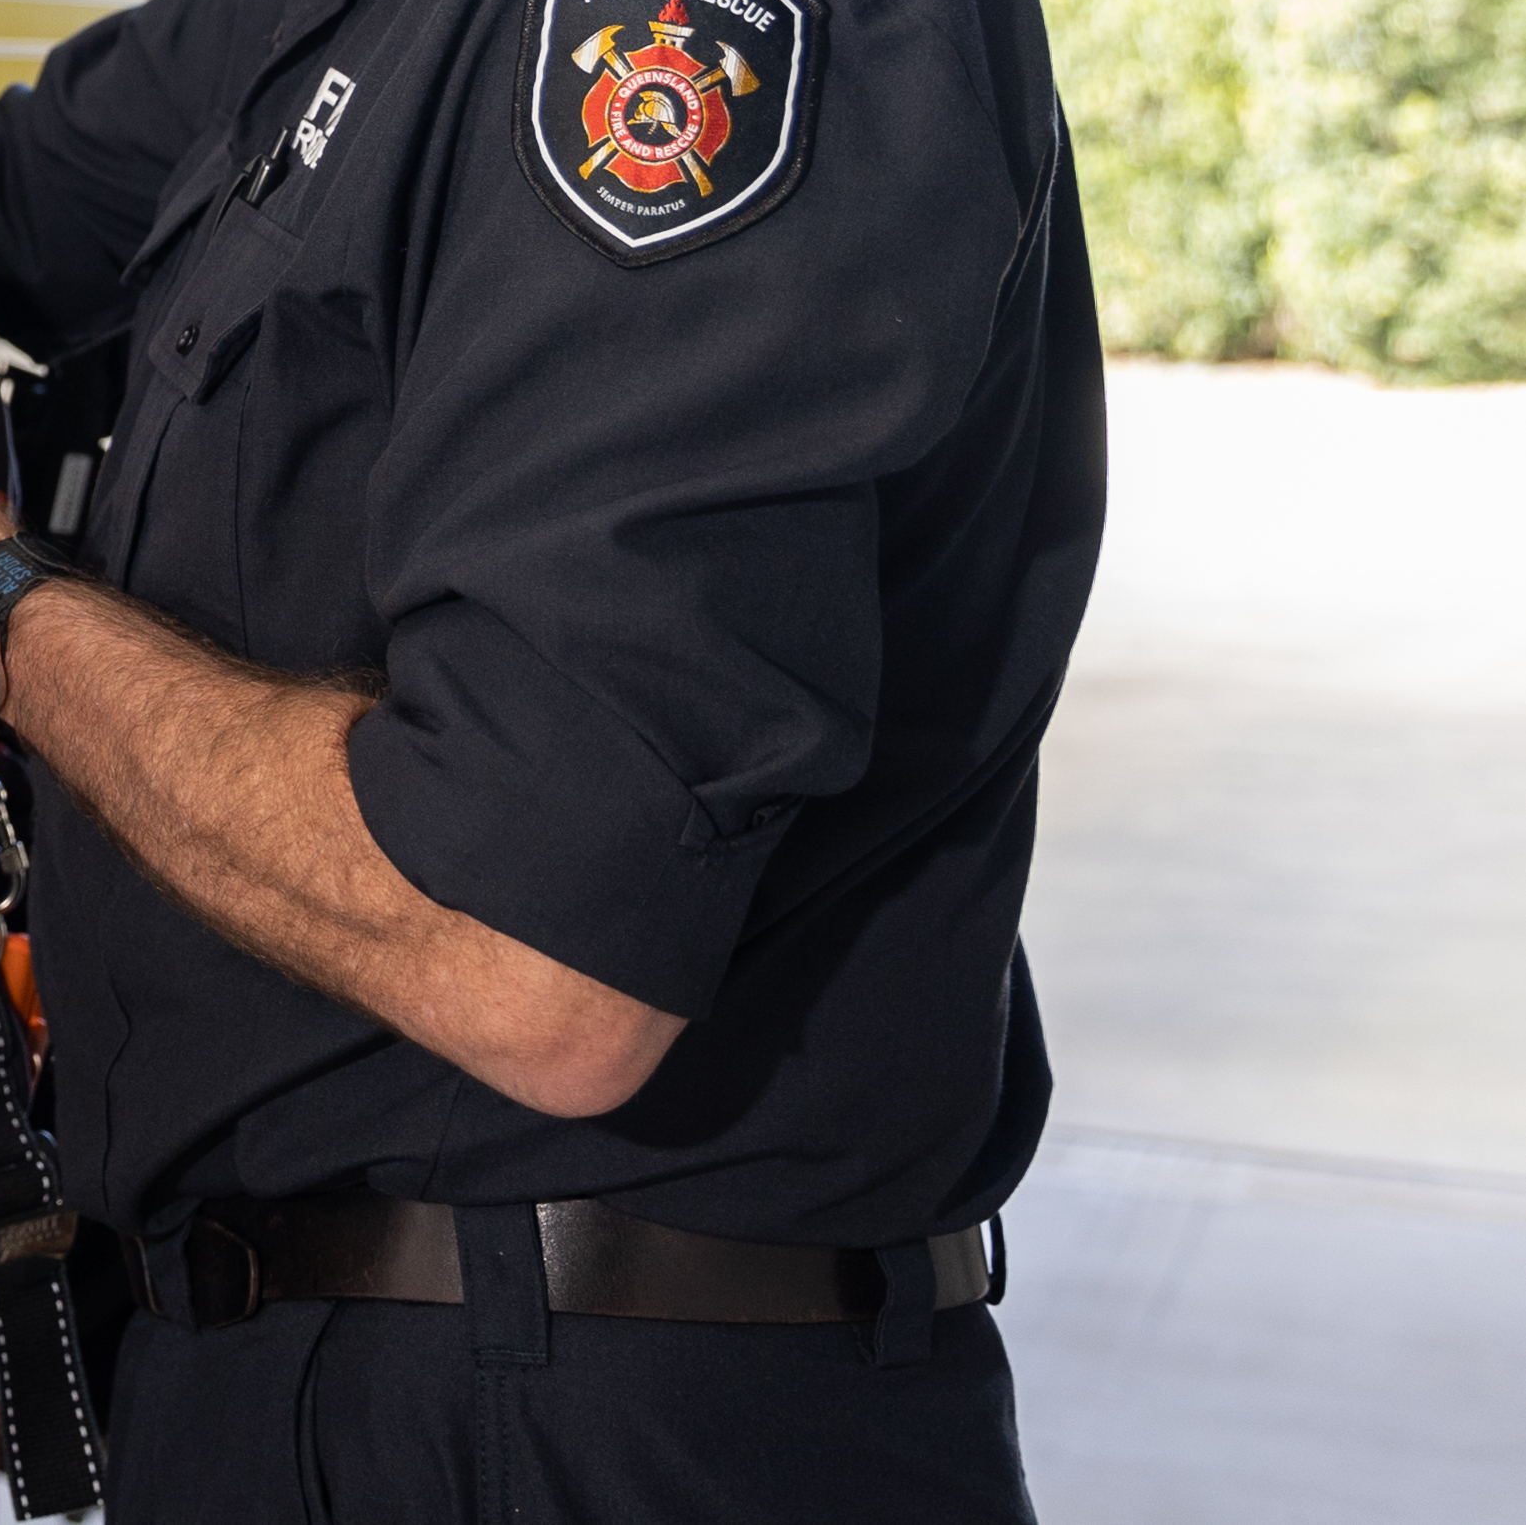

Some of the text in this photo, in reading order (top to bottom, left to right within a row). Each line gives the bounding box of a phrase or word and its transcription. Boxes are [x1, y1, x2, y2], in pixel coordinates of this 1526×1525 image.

[618, 71, 699, 111] QUEENSLAND
[610, 111, 699, 159] FIRE AND RESCUE
[596, 186, 686, 216] SEMPER PARATUS
